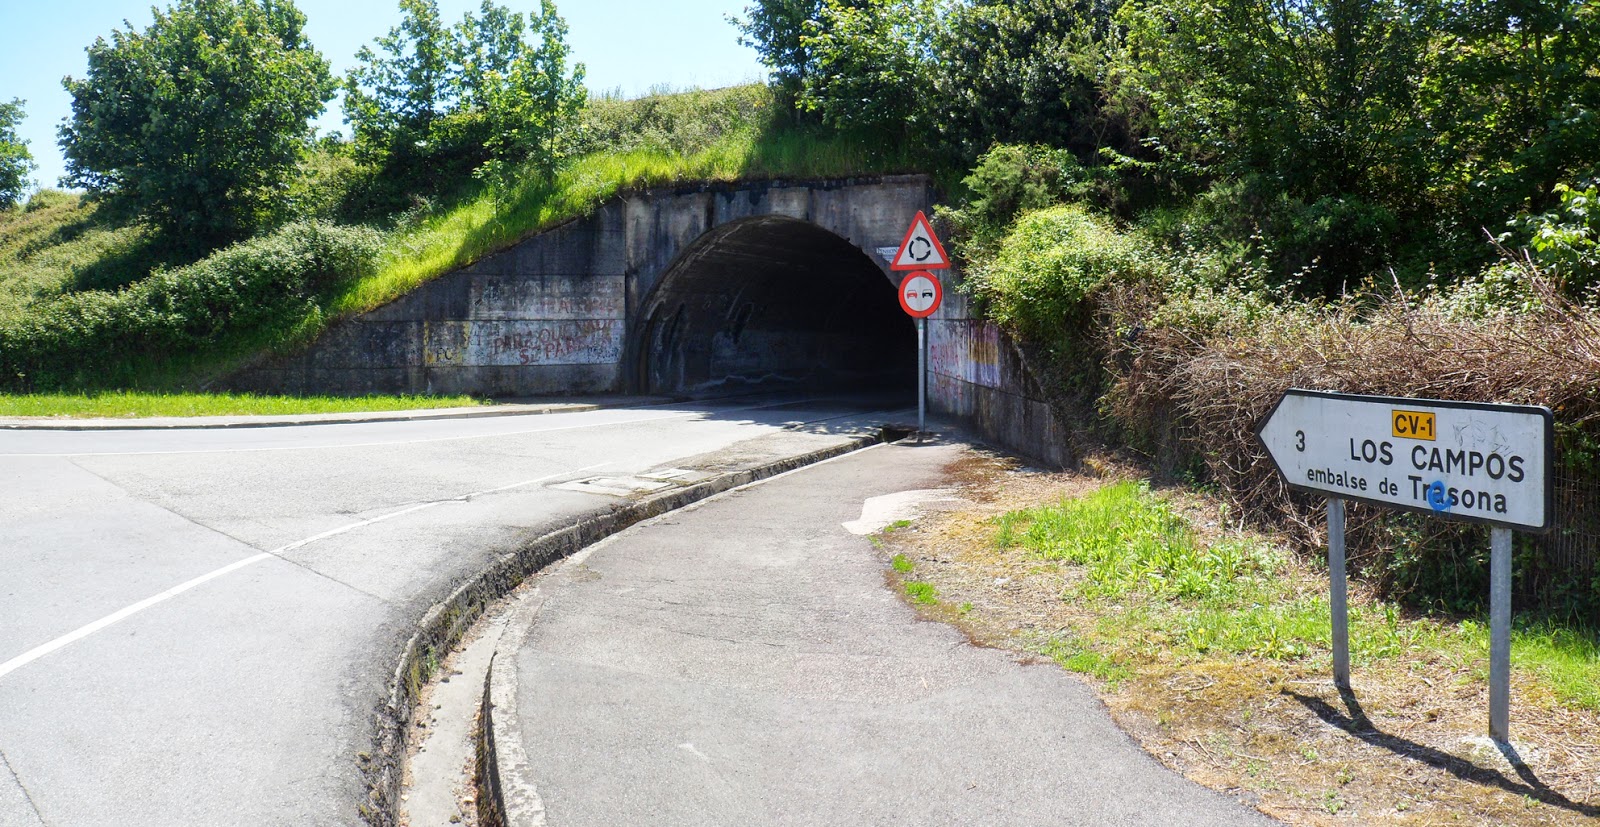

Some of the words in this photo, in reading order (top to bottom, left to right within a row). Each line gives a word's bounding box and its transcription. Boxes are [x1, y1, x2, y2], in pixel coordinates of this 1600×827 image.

[1395, 413, 1434, 437] CV-1
[1295, 430, 1306, 452] 3
[1350, 437, 1394, 466] LOS
[1411, 445, 1525, 483] CAMPOS
[1307, 467, 1368, 491] embalse
[1379, 477, 1399, 497] de
